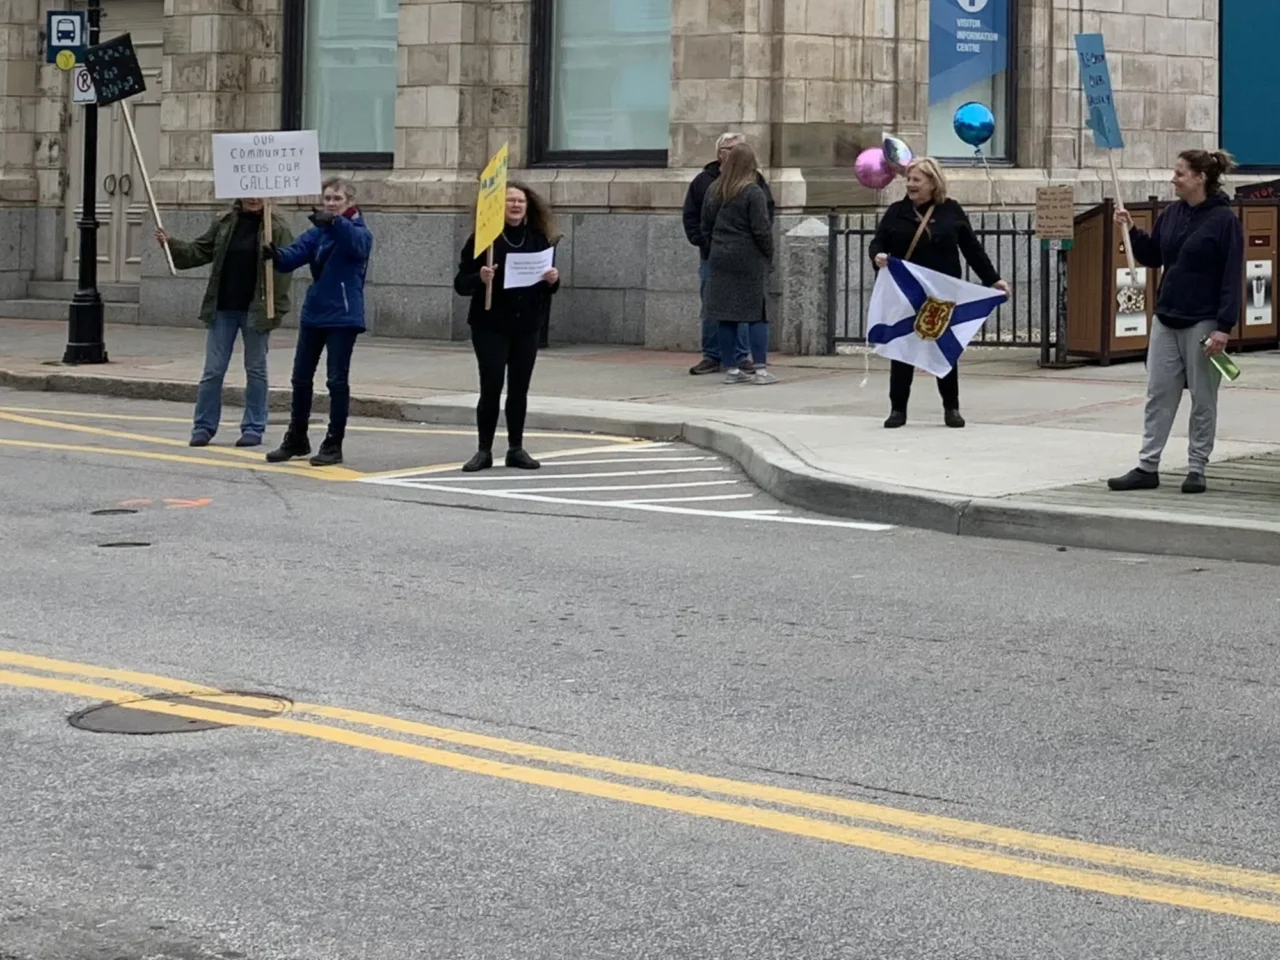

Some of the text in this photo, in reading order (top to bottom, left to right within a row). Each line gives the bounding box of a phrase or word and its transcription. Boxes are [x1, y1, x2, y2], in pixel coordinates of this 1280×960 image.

[956, 18, 981, 28] VISITOR
[956, 30, 998, 42] INFORMATION
[956, 43, 981, 53] CENTRE
[253, 135, 275, 146] OUR
[230, 147, 305, 160] COMMUNITY
[233, 162, 300, 174] NEEDS OUR
[240, 176, 300, 191] GALLERY
